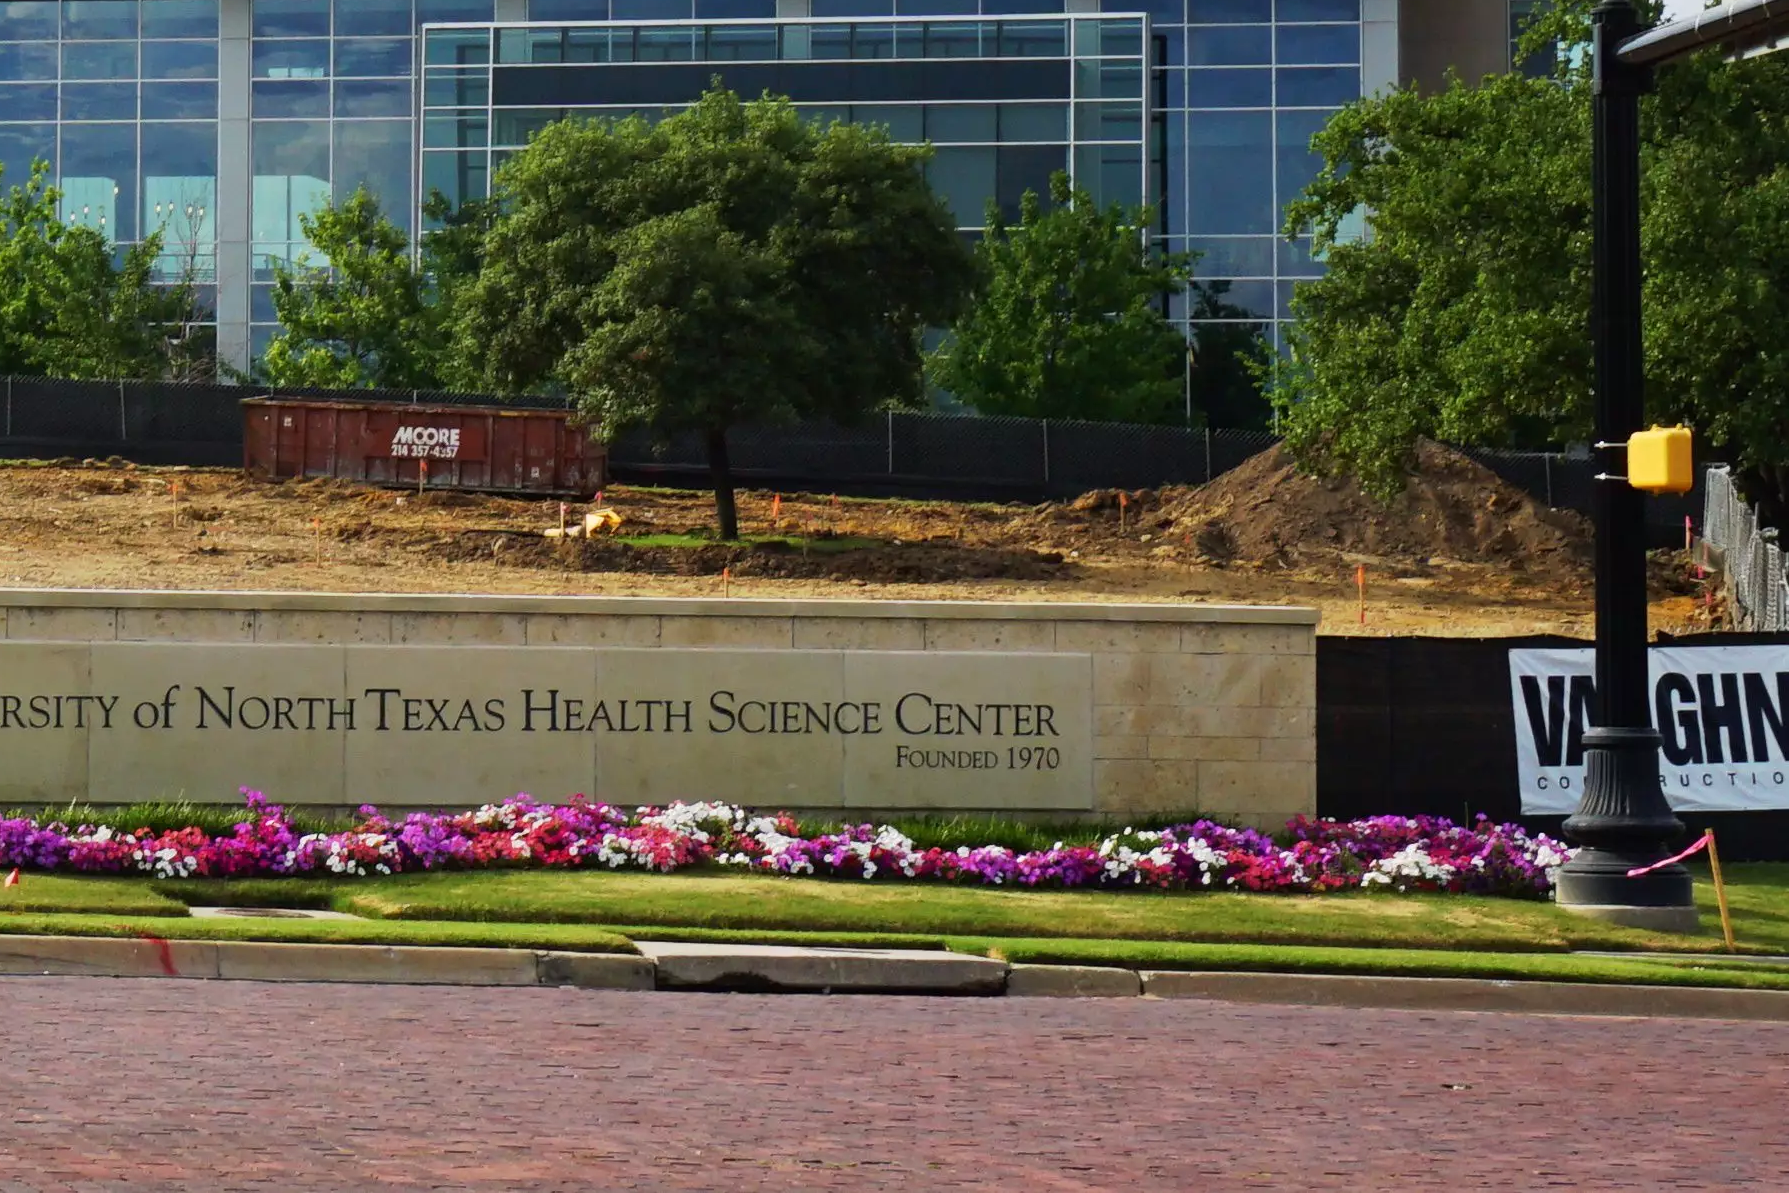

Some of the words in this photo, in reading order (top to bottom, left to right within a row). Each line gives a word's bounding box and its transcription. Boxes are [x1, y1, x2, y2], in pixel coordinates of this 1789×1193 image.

[392, 427, 460, 445] MOORE
[391, 444, 408, 456] 214
[134, 685, 180, 729] of
[195, 687, 357, 731] NORTH
[365, 688, 505, 732] TEXAS
[520, 689, 692, 733] HEALTH
[708, 691, 882, 735] SCIENCE
[895, 693, 1059, 737] CENTER
[1519, 672, 1789, 767] VAGHN
[896, 745, 998, 770] FOUNDED
[1007, 747, 1059, 770] 1970
